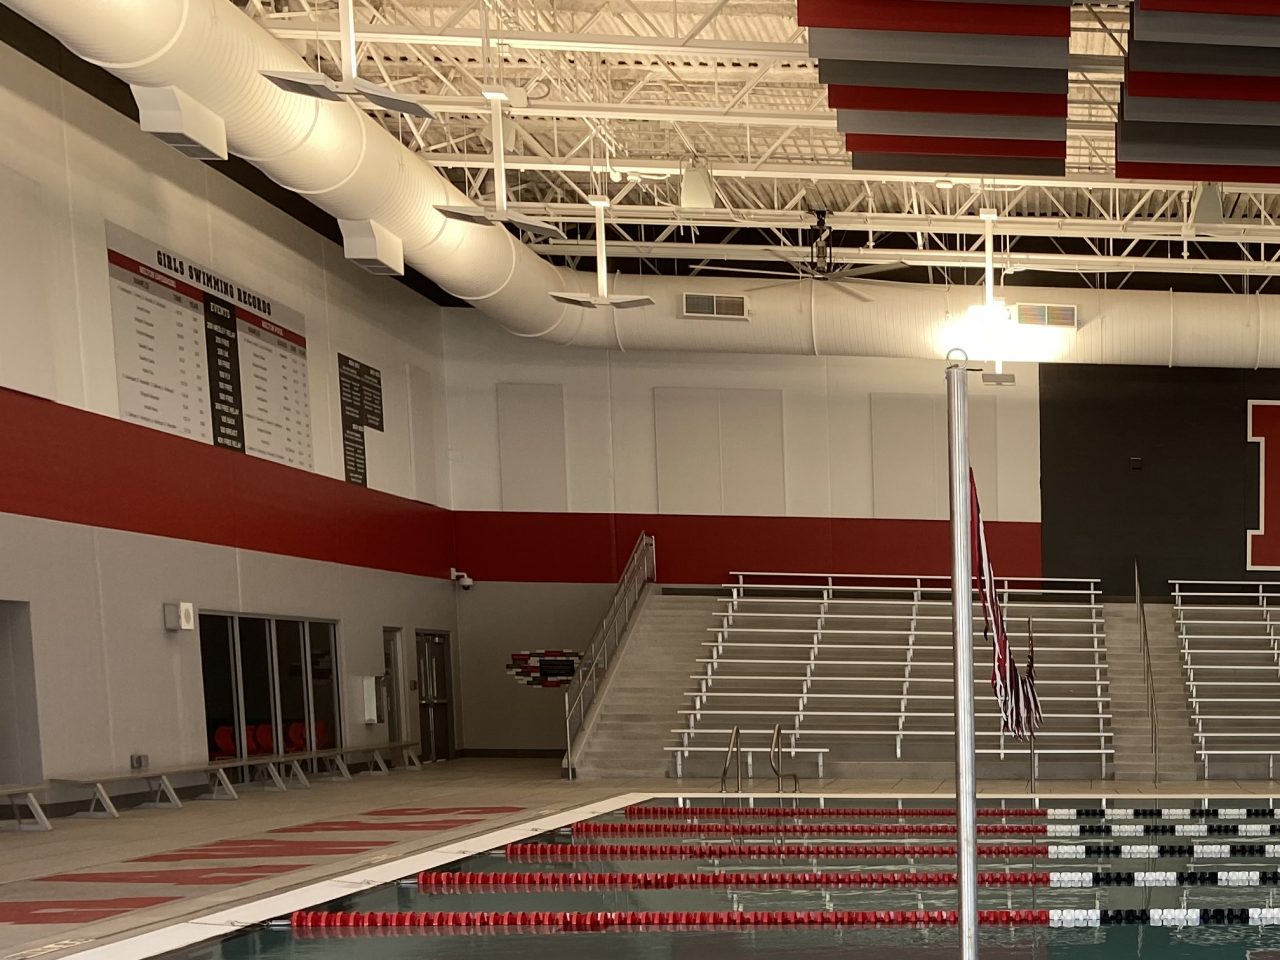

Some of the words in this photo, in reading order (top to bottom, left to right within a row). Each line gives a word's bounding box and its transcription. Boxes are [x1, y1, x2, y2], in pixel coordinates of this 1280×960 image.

[156, 250, 185, 275] GIRLS
[188, 265, 234, 298] SWIMMING
[237, 287, 272, 316] RECORDS
[210, 302, 230, 319] EVENTS
